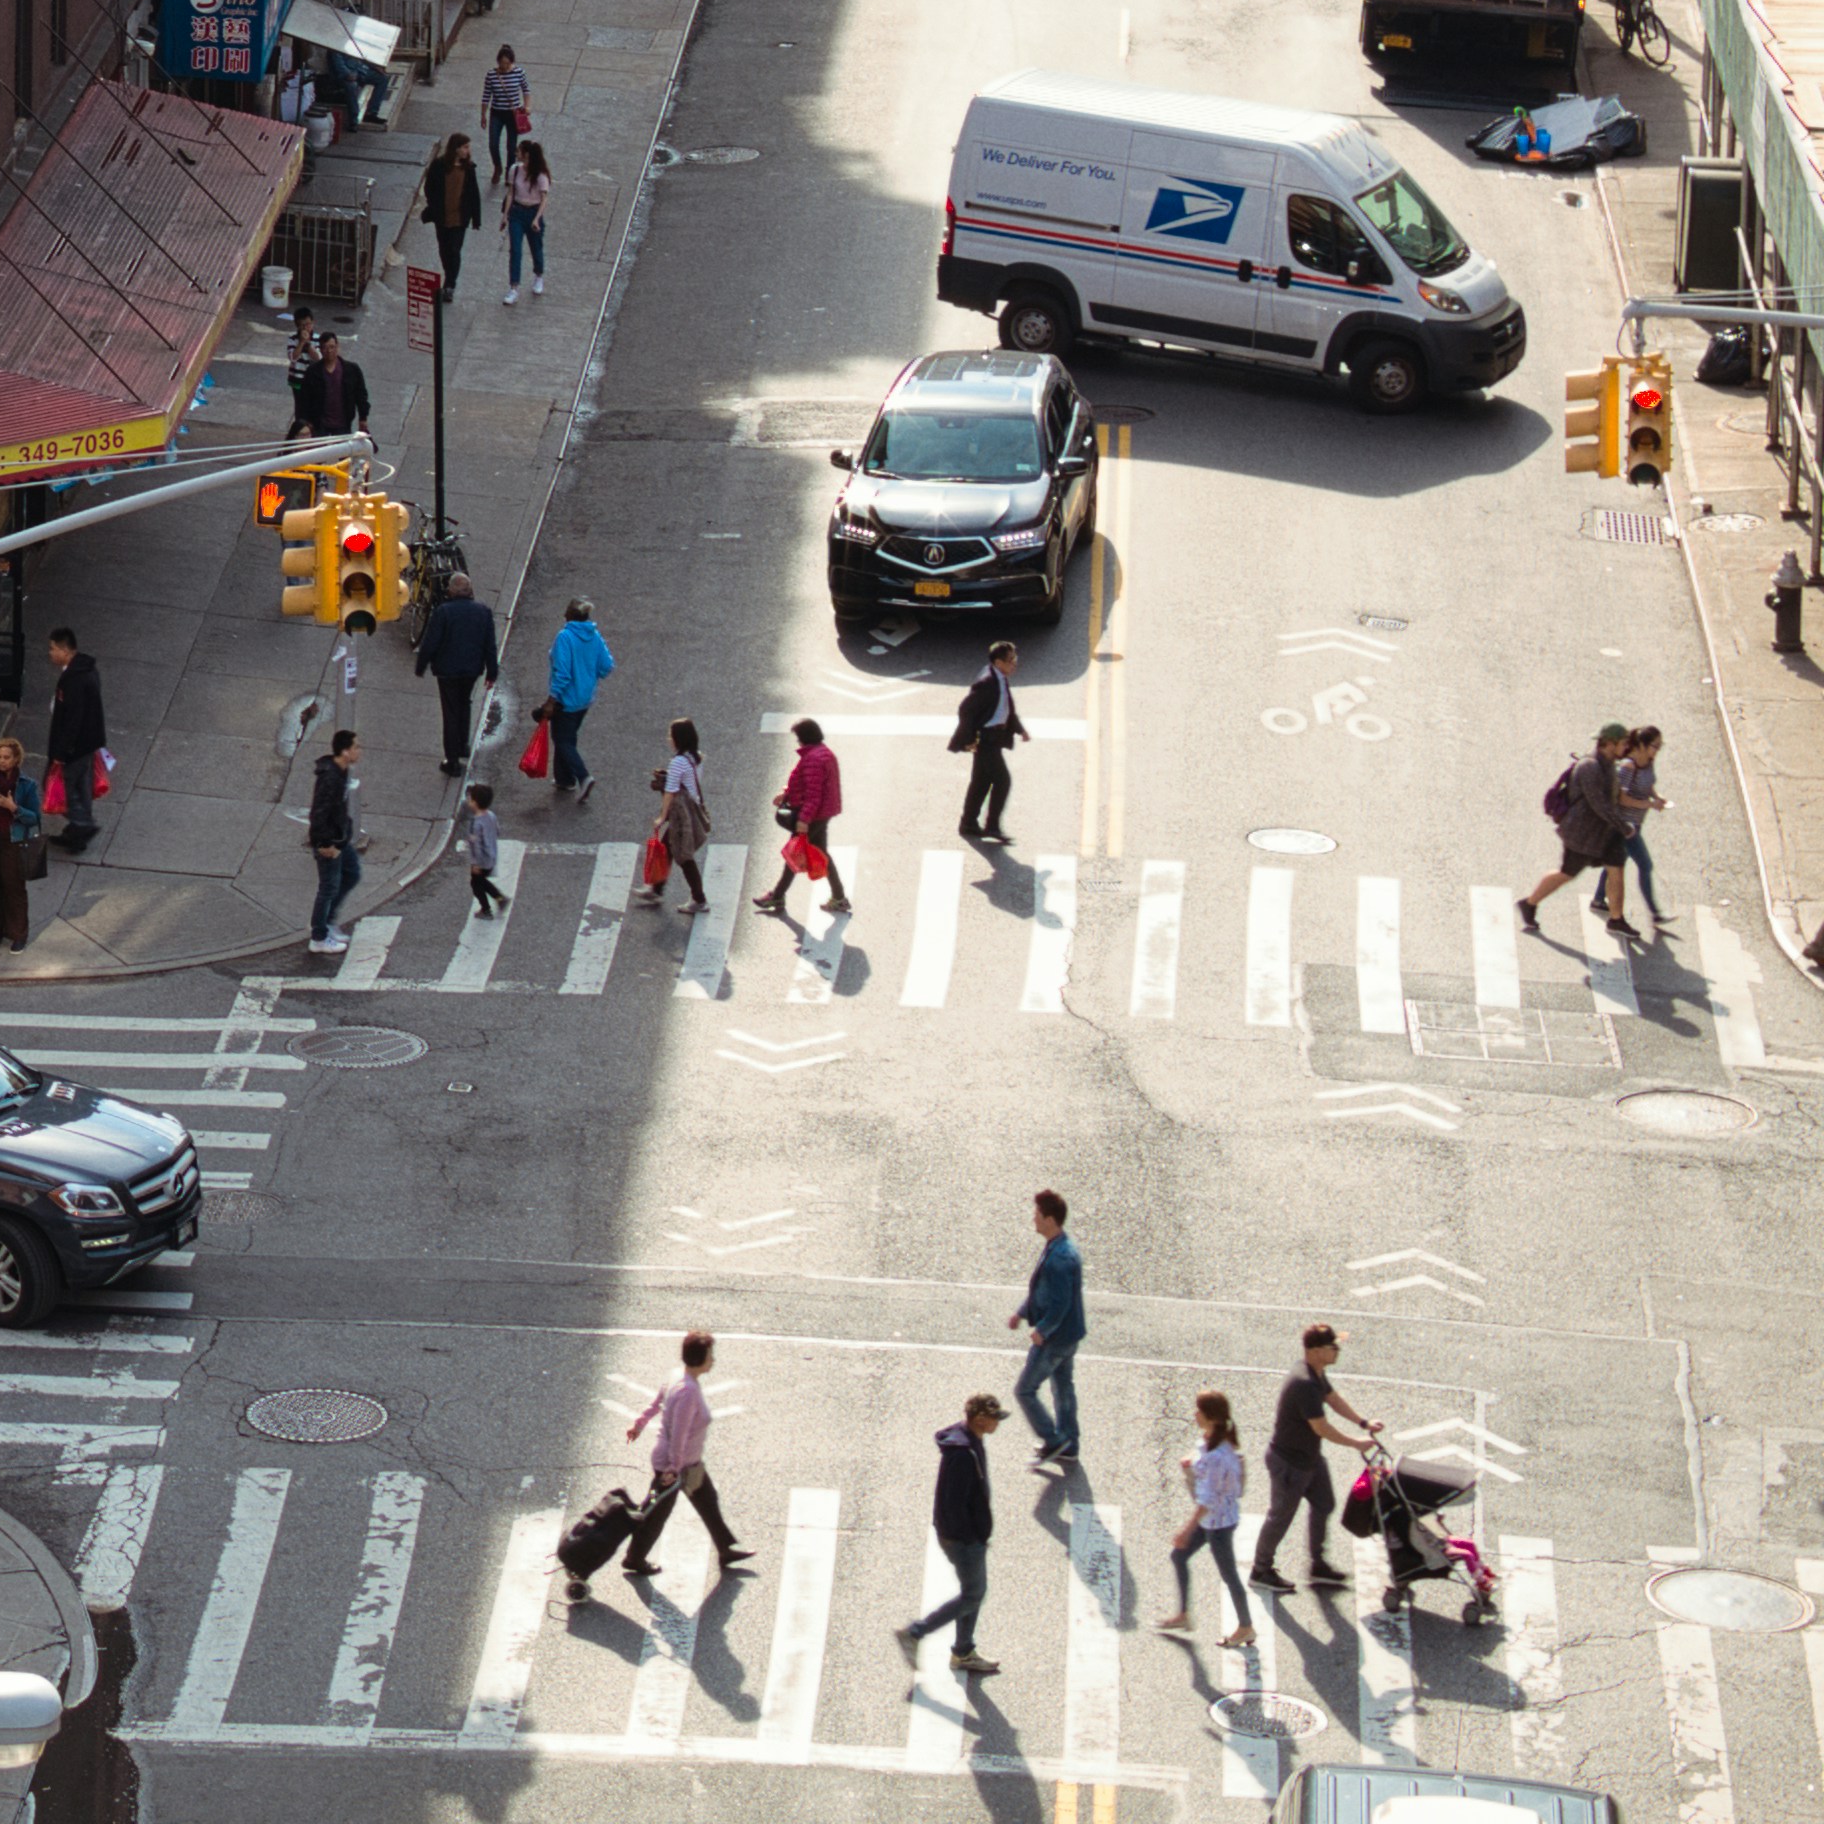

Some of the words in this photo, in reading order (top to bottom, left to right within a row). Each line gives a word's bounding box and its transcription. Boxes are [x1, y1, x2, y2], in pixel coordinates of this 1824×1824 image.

[190, 15, 252, 44] 漢藝
[190, 45, 251, 74] 印刷
[982, 148, 1005, 164] We
[1006, 151, 1059, 173] Deliver
[1059, 160, 1085, 177] For
[1087, 164, 1116, 182] You.
[976, 190, 1048, 210] www.usps.com
[18, 428, 125, 465] 349-7036
